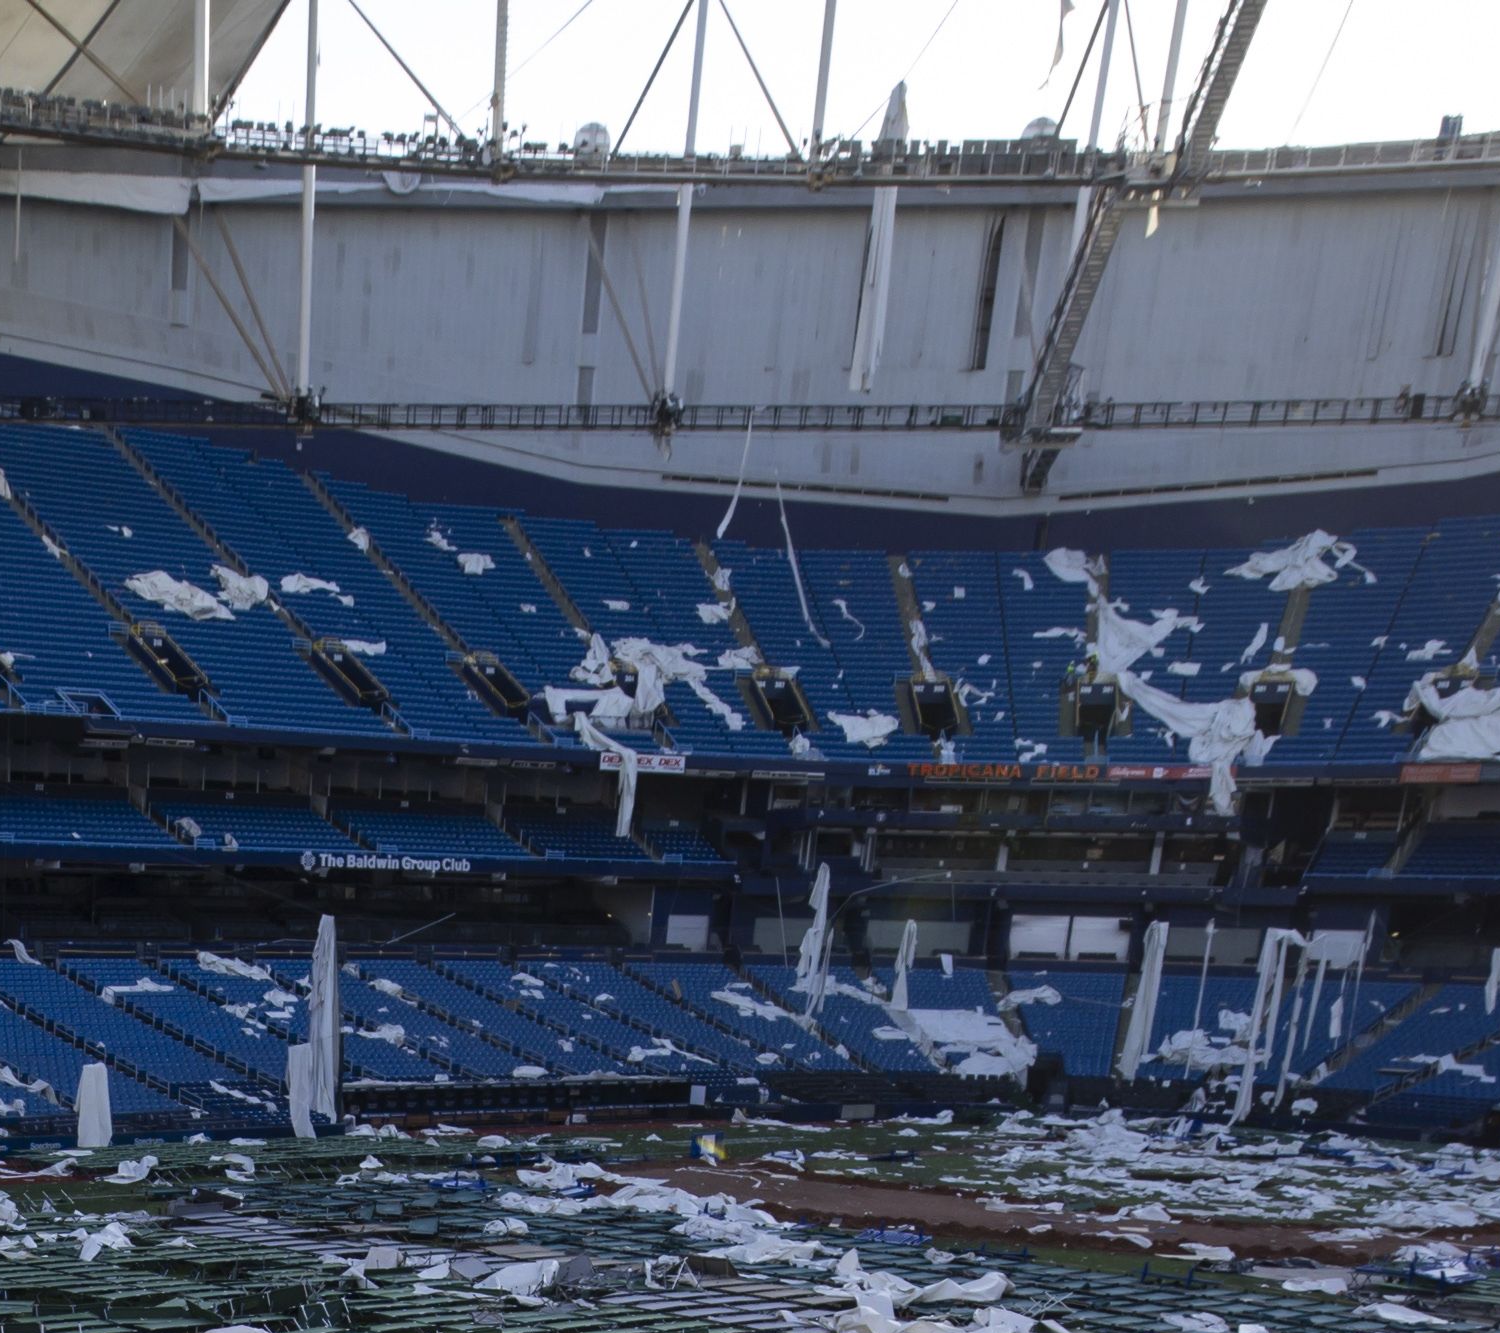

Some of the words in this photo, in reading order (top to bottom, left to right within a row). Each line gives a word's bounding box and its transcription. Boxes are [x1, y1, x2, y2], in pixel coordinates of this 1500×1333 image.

[907, 763, 1021, 779] TROPICANA
[1036, 764, 1099, 779] FIELD
[320, 853, 344, 868] The
[346, 853, 399, 869] Baldwin
[401, 856, 440, 872] Group
[442, 857, 471, 873] Club
